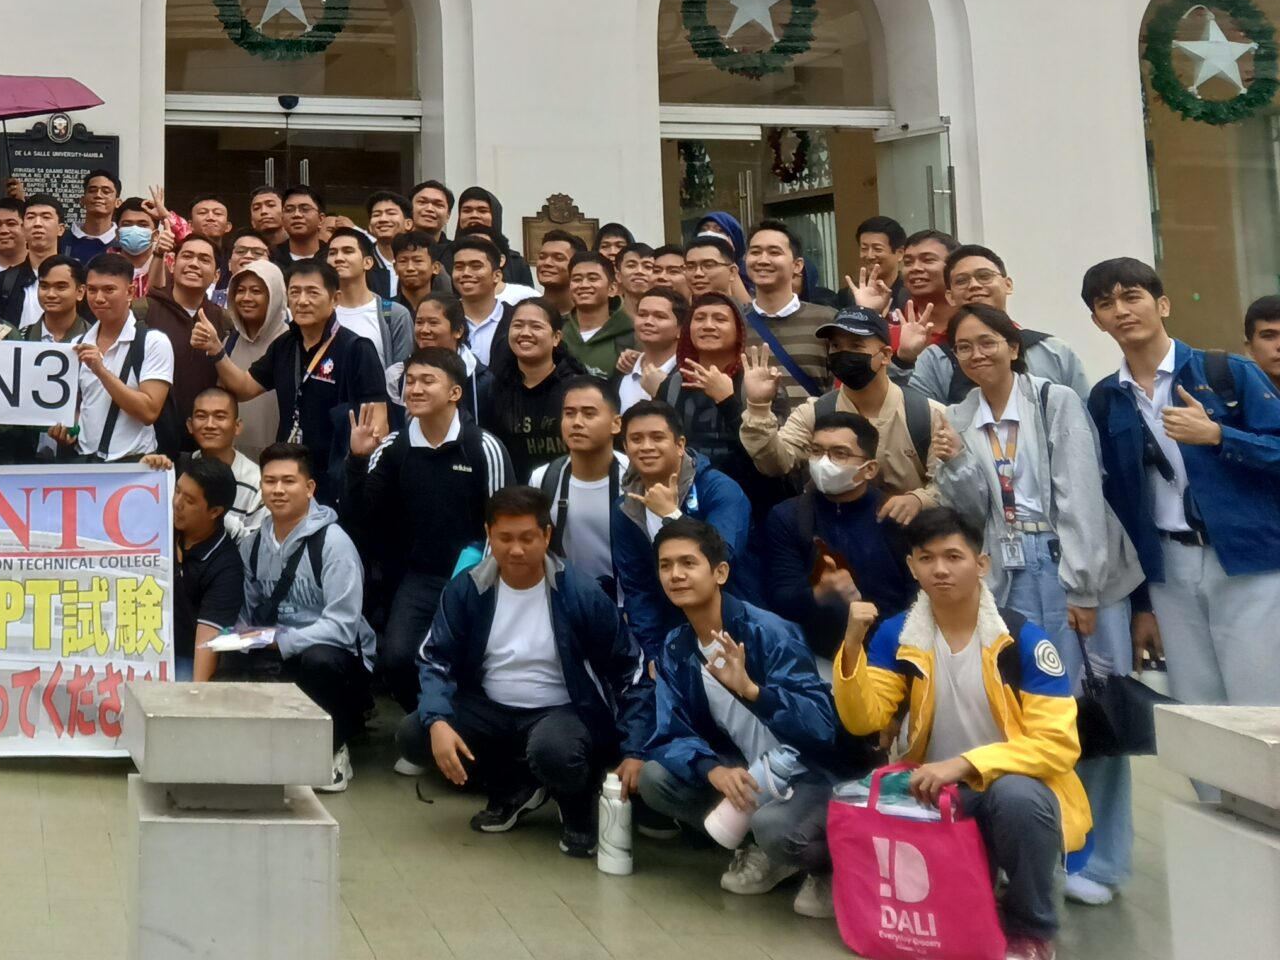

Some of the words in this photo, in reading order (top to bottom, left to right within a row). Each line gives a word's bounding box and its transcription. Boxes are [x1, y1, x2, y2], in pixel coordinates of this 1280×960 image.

[19, 556, 96, 571] TECHNICAL
[99, 554, 161, 569] COLLEGE
[880, 904, 937, 937] DALI
